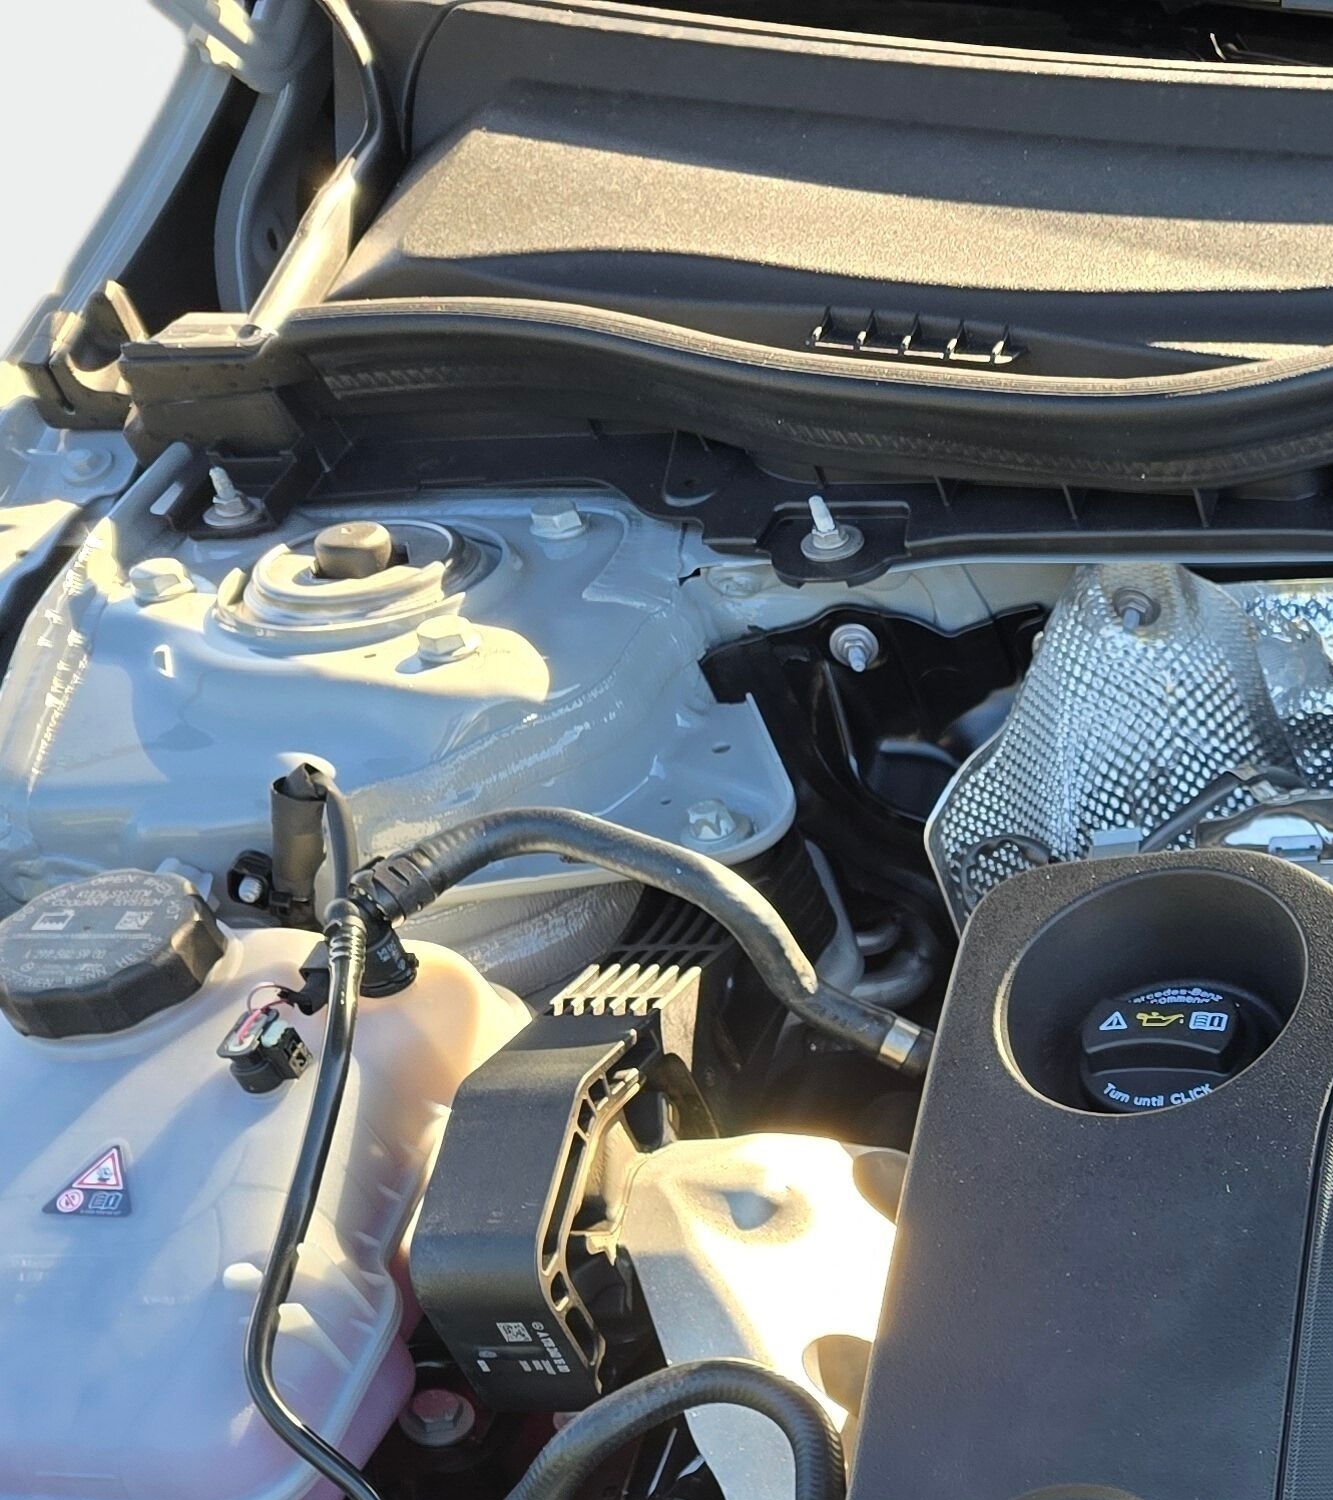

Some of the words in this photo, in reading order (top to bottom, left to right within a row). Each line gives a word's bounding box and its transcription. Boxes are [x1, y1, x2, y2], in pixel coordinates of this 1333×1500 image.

[1103, 1082, 1131, 1103] Turn
[1133, 1095, 1164, 1107] until
[1169, 1083, 1214, 1106] CLICK
